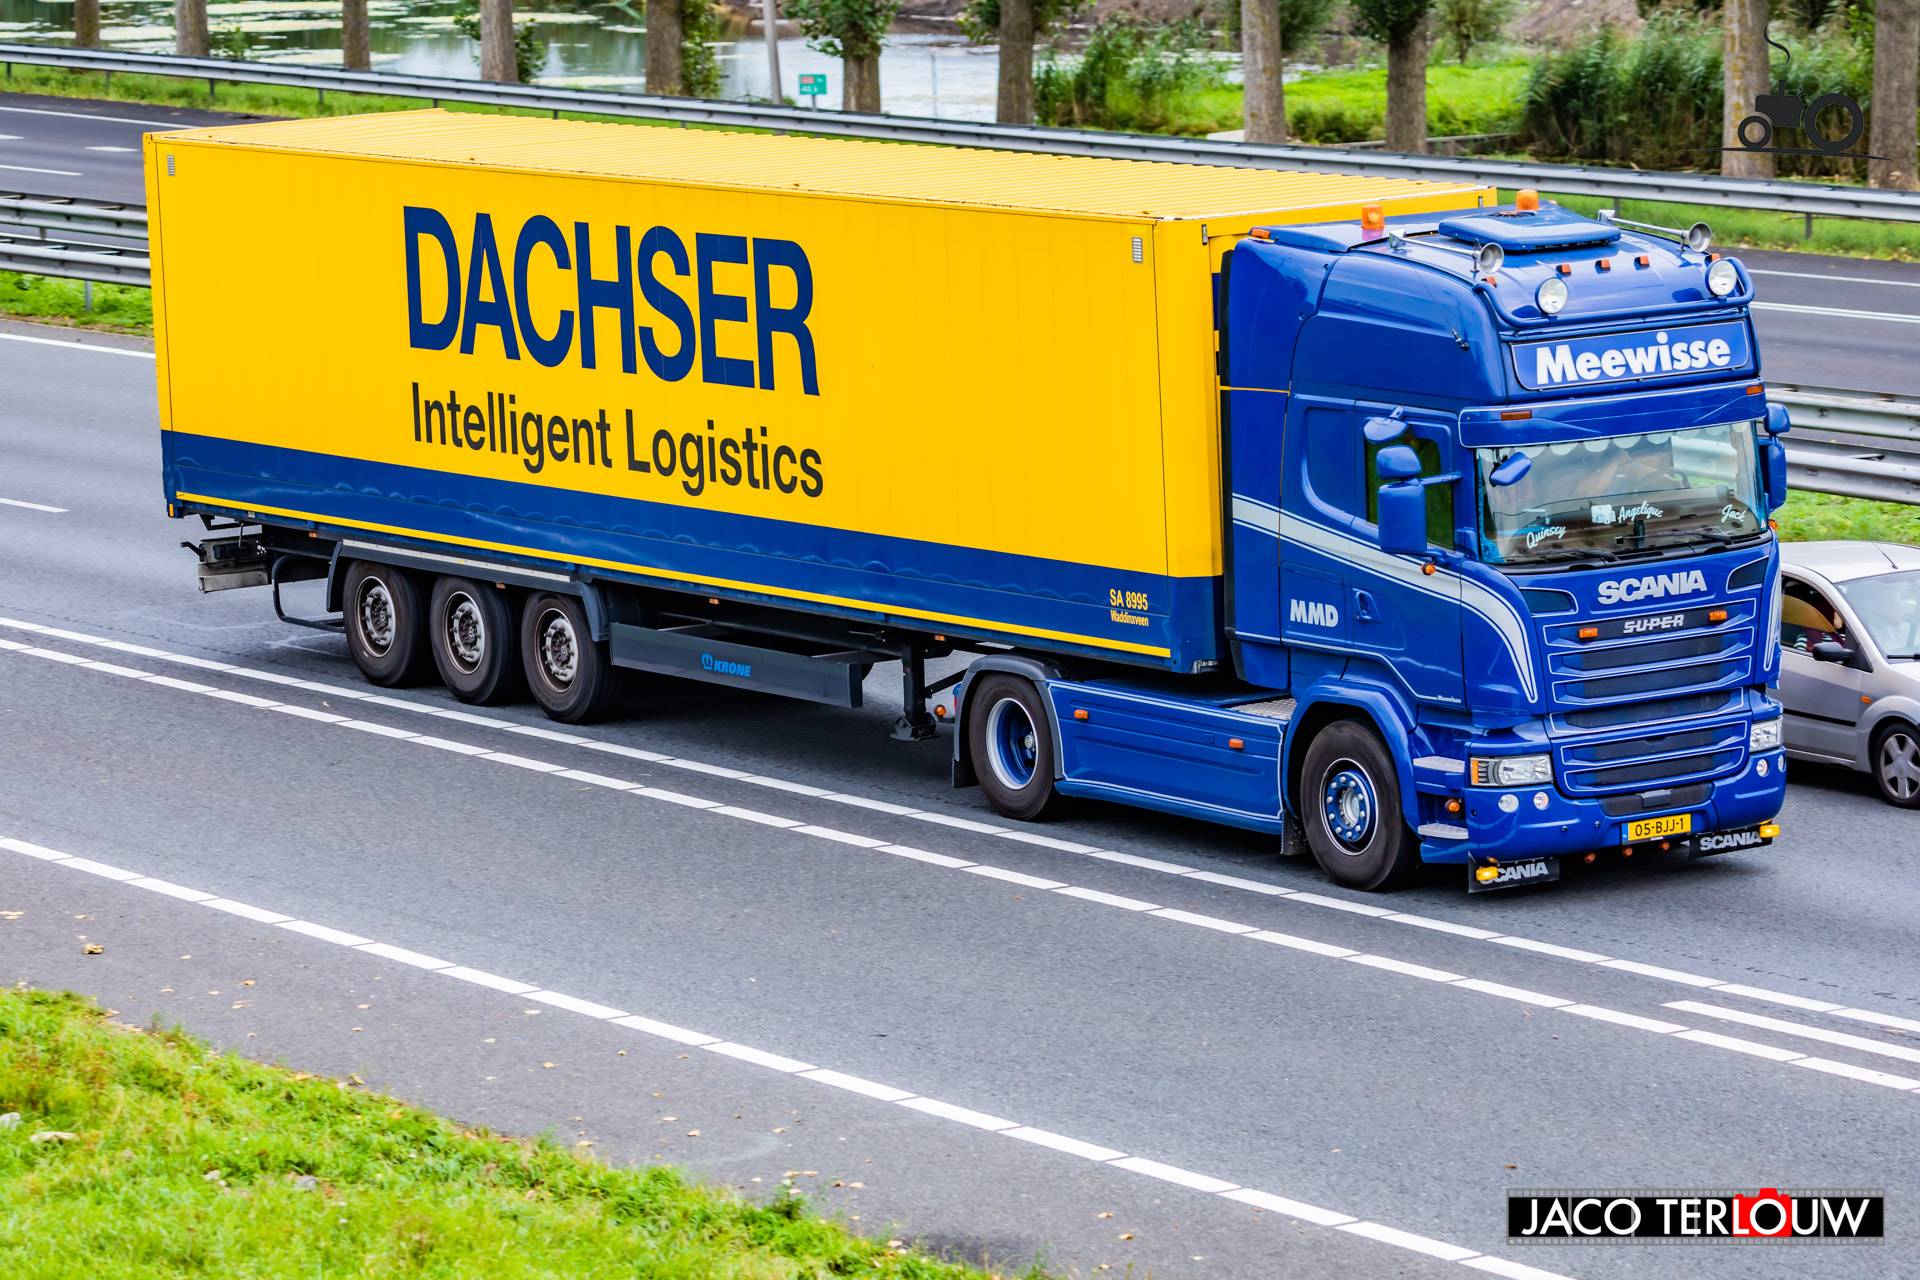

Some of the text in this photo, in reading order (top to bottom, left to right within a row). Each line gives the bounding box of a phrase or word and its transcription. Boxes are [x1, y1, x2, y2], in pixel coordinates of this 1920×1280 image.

[404, 206, 820, 396] DACHSER
[1536, 332, 1731, 384] Meewisse
[412, 382, 824, 497] Intelligent Logistics
[1618, 501, 1664, 523] Angelique
[1721, 504, 1745, 522] Jack
[1598, 570, 1707, 605] SCANIA
[1110, 588, 1149, 611] SA 8995
[1290, 599, 1339, 628] MMD
[1623, 615, 1685, 634] SUPER
[714, 659, 751, 677] KRONE
[1635, 817, 1684, 837] 05-BJJ-1
[1700, 831, 1762, 851] SCANIA
[1478, 861, 1549, 885] CANIA
